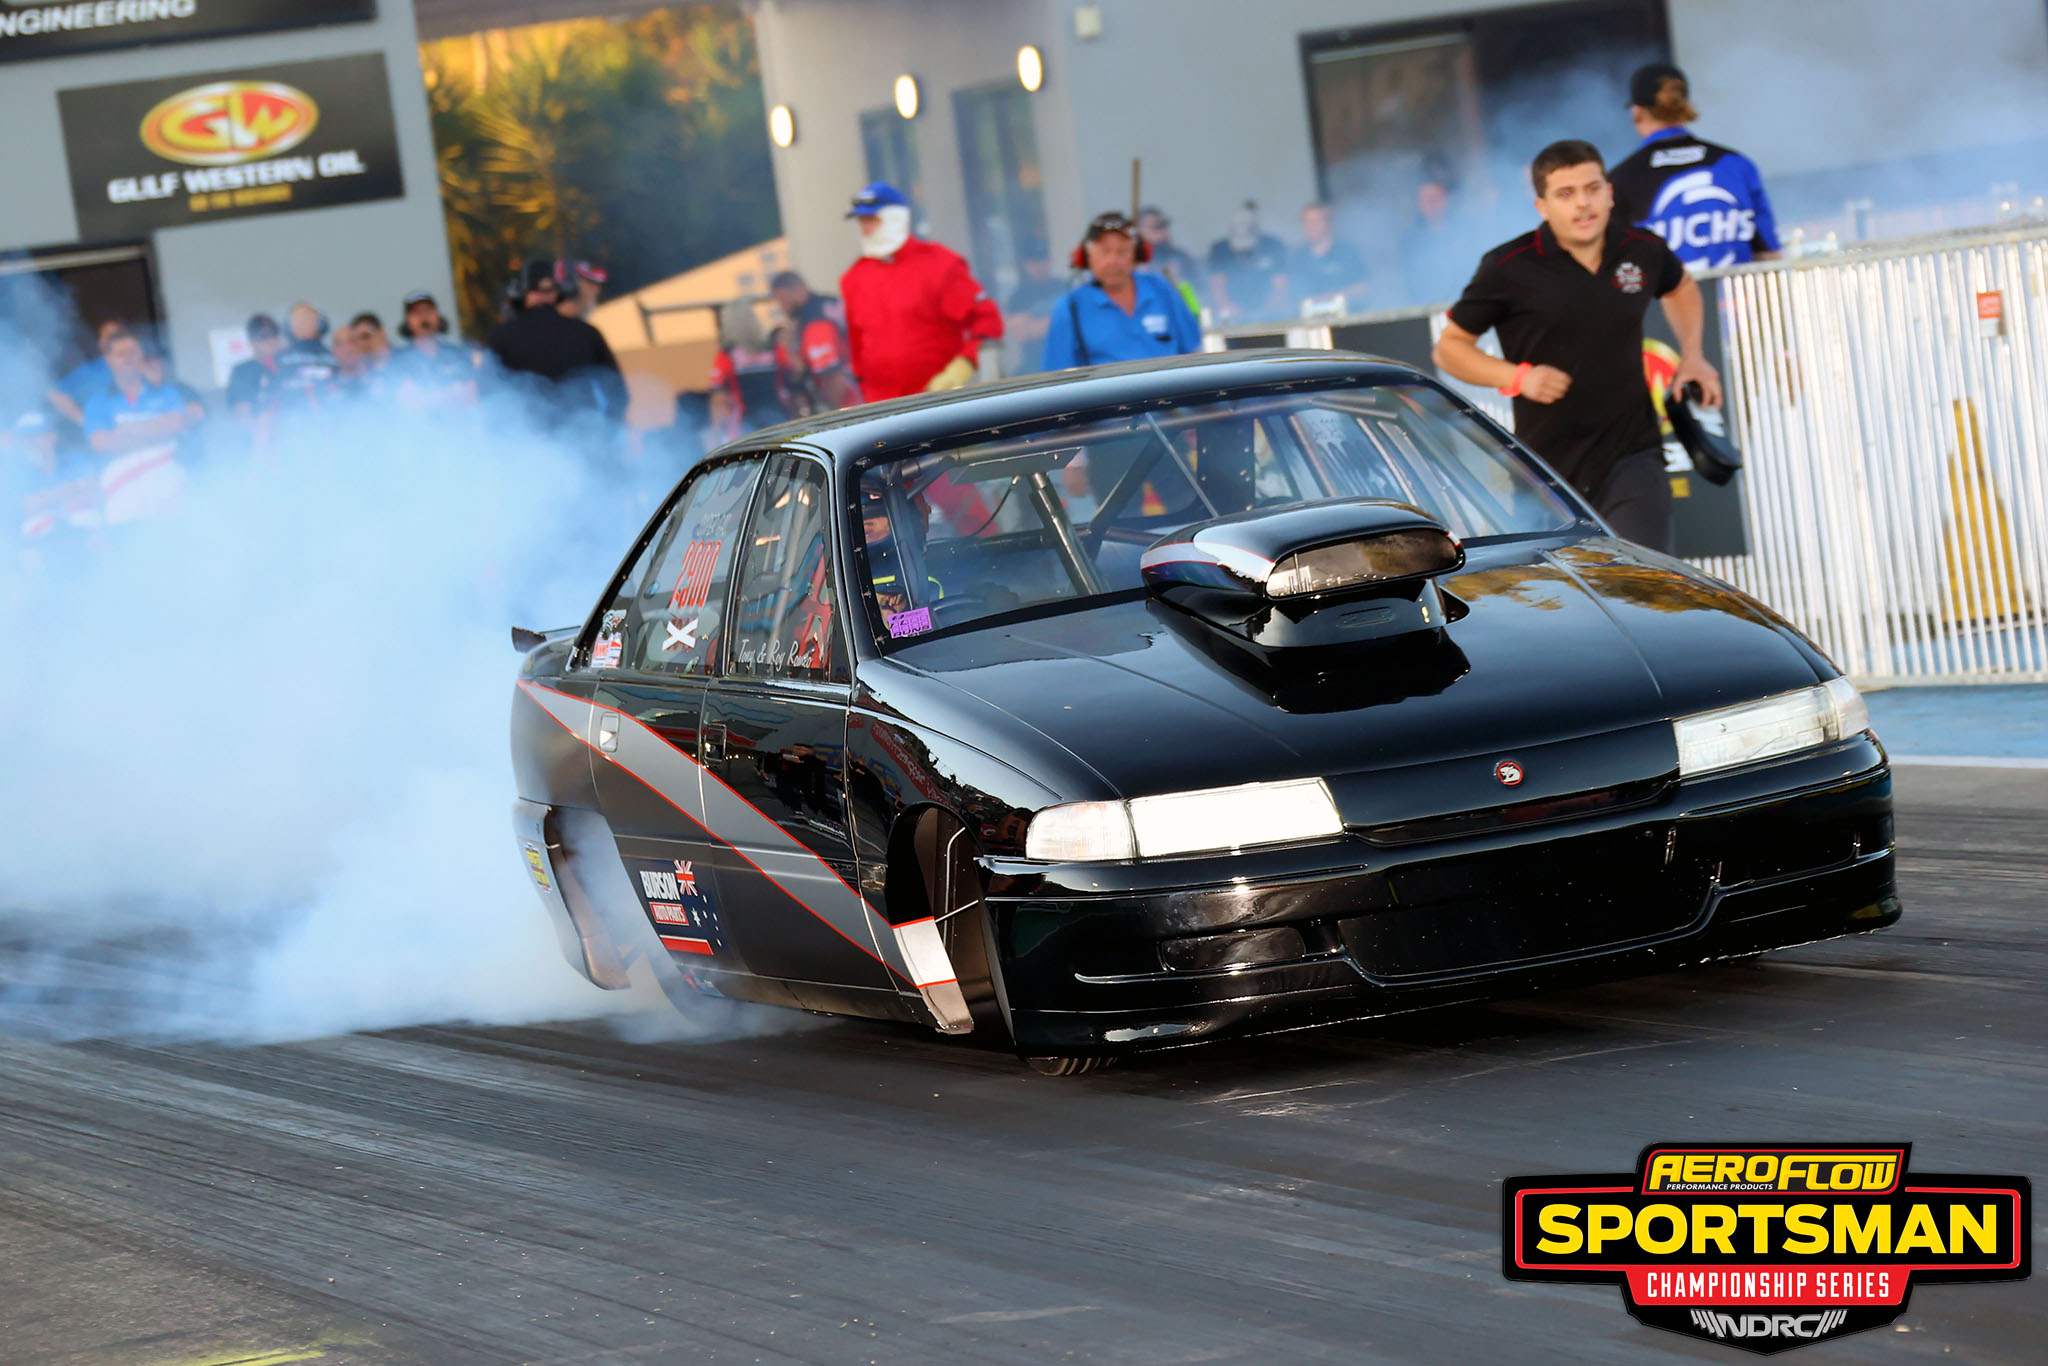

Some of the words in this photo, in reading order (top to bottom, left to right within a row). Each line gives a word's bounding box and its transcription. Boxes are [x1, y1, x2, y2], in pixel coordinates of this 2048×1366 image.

[107, 172, 180, 204] GULF
[182, 156, 315, 194] WESTERN
[317, 150, 367, 177] OIL
[1647, 208, 1756, 251] UCHS
[757, 642, 767, 664] &
[769, 639, 786, 672] Roy
[640, 870, 680, 900] BURSON
